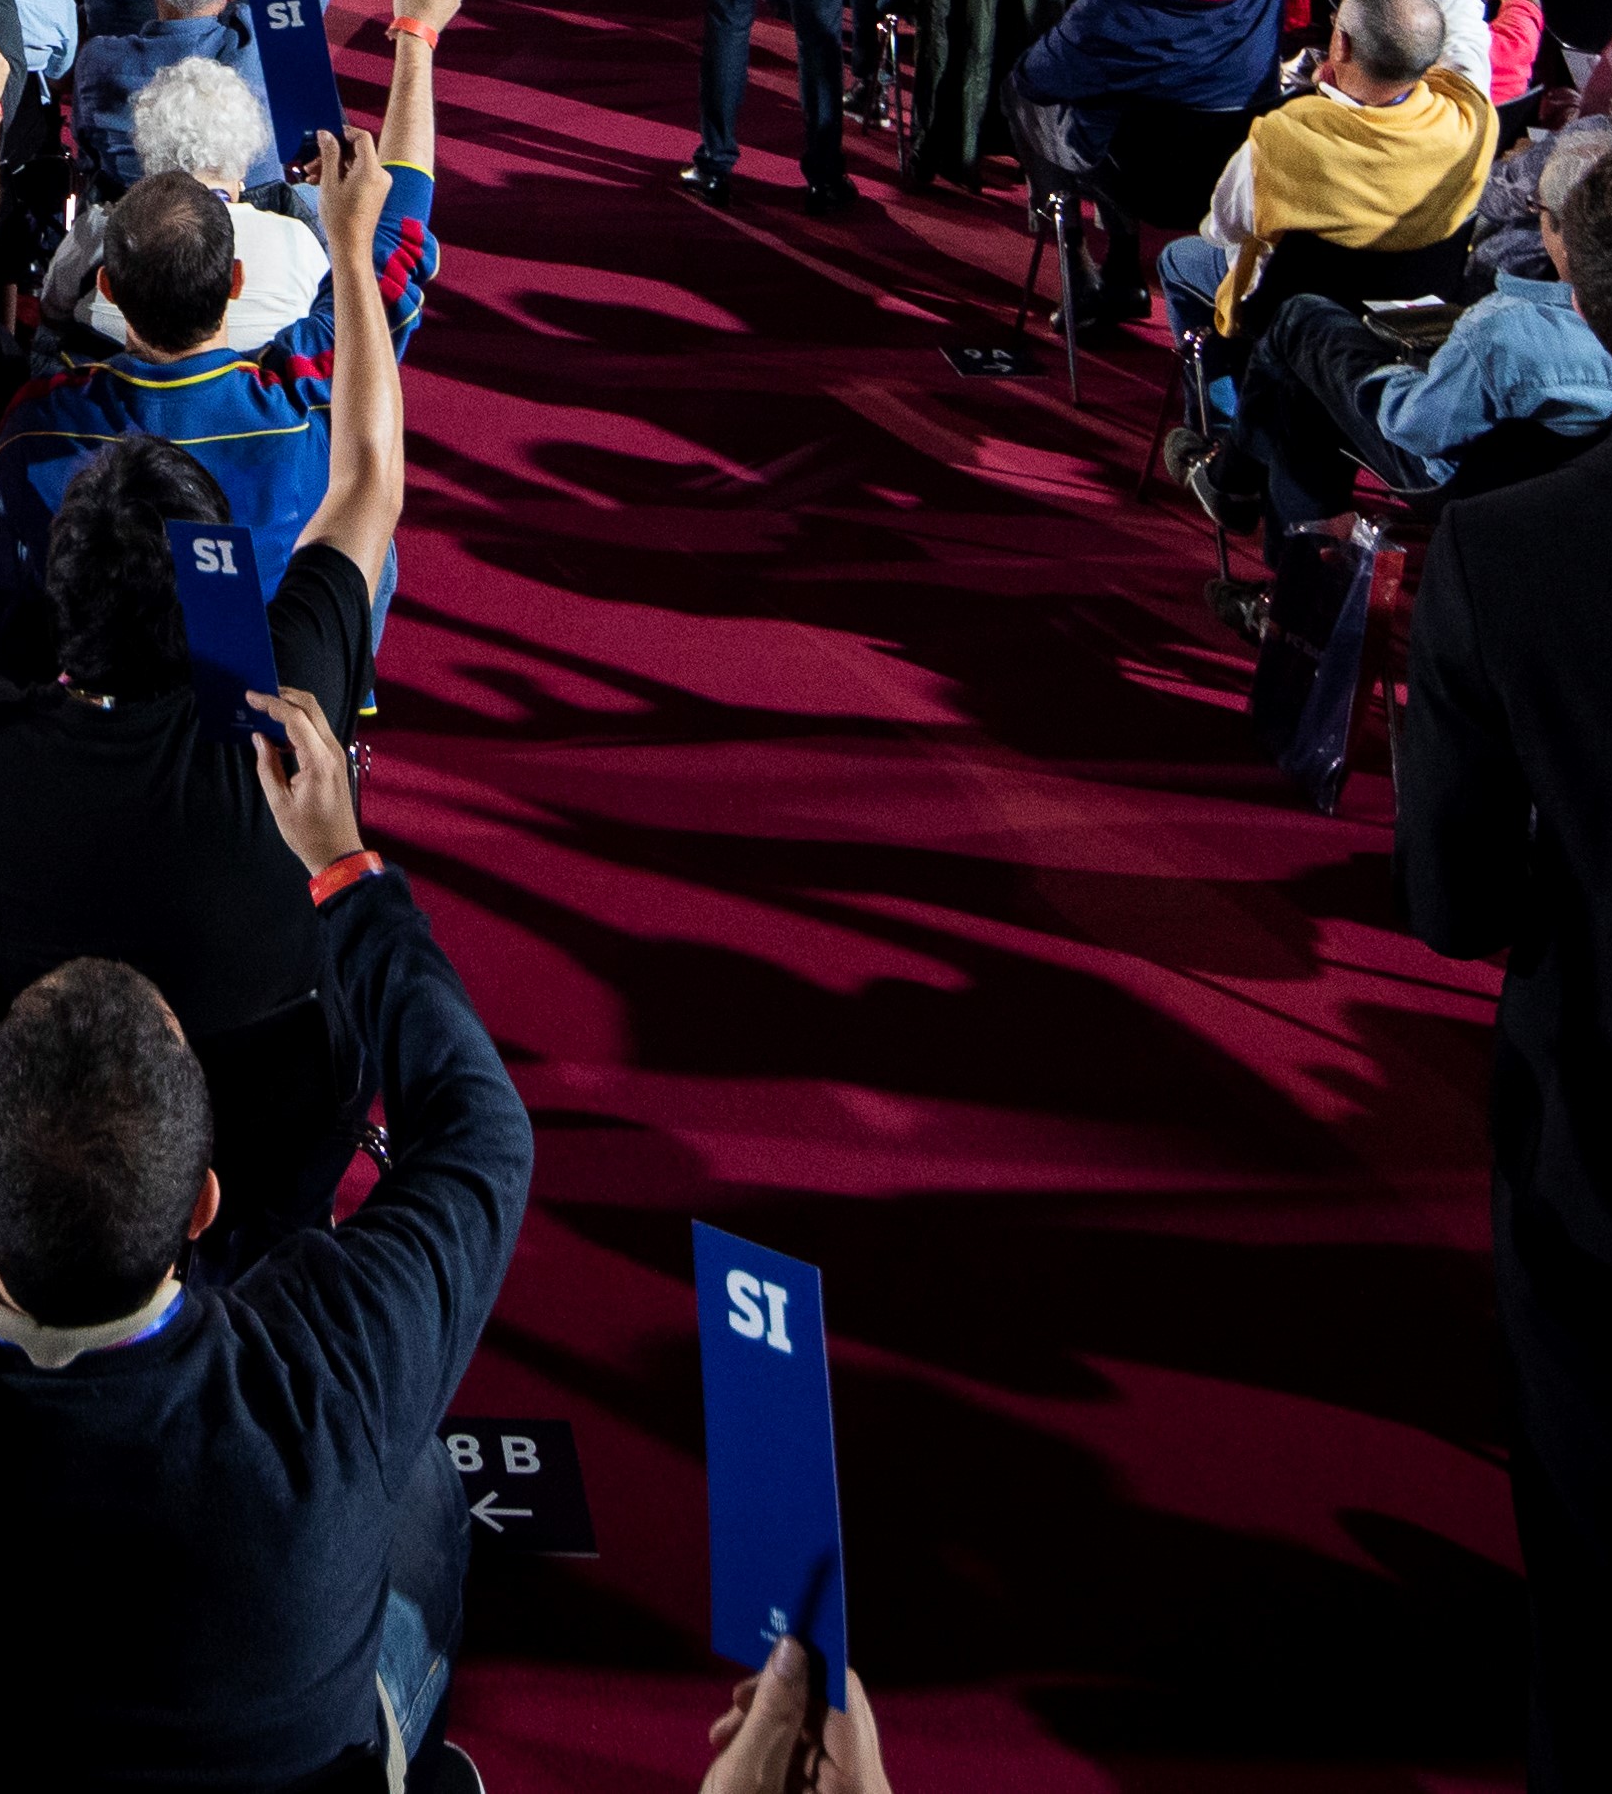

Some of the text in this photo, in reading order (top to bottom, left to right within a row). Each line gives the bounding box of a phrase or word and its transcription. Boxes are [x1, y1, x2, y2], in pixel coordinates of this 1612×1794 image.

[267, 0, 305, 29] SI
[193, 538, 238, 574] SI
[726, 1270, 792, 1353] SI
[446, 1434, 542, 1474] 8 B
